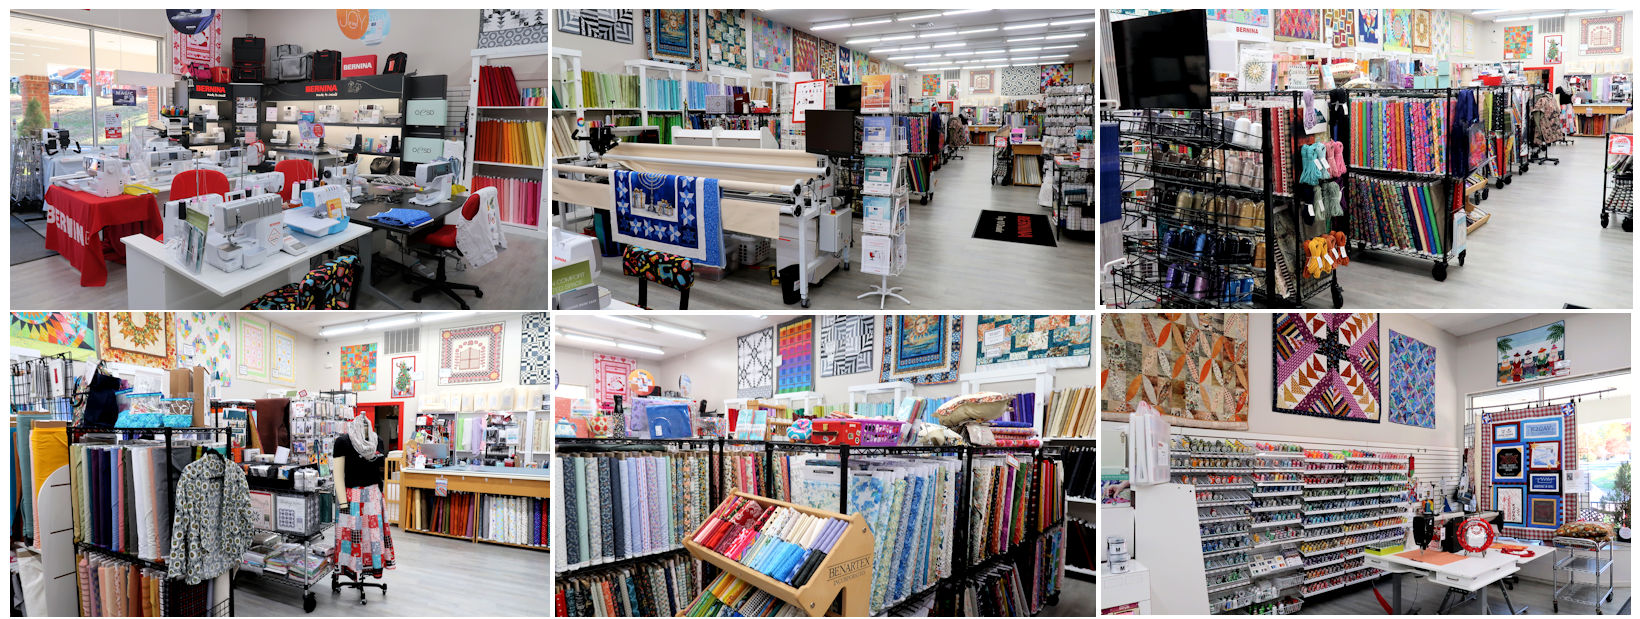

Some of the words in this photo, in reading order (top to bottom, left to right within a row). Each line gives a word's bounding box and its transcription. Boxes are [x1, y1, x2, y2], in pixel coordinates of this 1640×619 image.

[1235, 26, 1259, 34] BERNINA
[343, 62, 373, 71] BERNINA
[195, 84, 226, 94] BERNINA
[305, 84, 338, 93] BERNINA
[828, 556, 870, 578] BENARTEX
